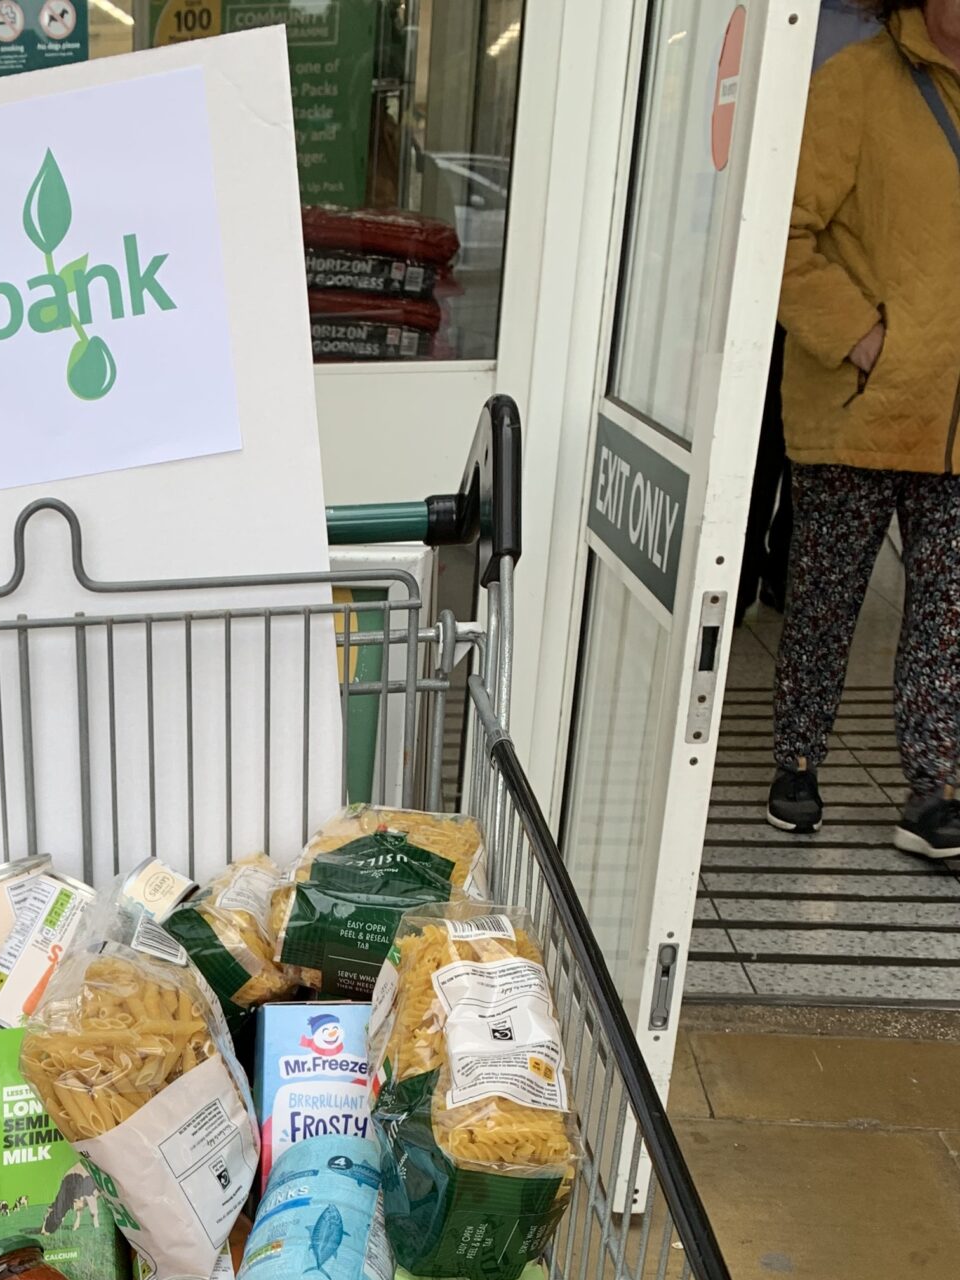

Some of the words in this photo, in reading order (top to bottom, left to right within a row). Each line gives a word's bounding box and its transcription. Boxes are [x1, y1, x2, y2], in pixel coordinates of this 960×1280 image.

[174, 8, 211, 33] 100
[302, 83, 338, 97] Packs
[316, 274, 384, 289] GOODNESS
[312, 326, 368, 340] ORIZON
[596, 444, 630, 529] EXIT
[628, 472, 681, 575] ONLY
[347, 920, 364, 930] EASY
[366, 922, 386, 933] OPEN
[340, 929, 356, 939] PEEL
[365, 932, 390, 944] RESEAL
[357, 941, 369, 950] TAB
[338, 970, 358, 981] SERVE
[3, 1101, 43, 1119] LON
[3, 1114, 50, 1133] SEMI
[290, 1111, 368, 1142] FROSTY
[3, 1128, 65, 1149] SKIMM
[3, 1145, 52, 1166] MILK
[45, 1251, 78, 1262] CALCIUM
